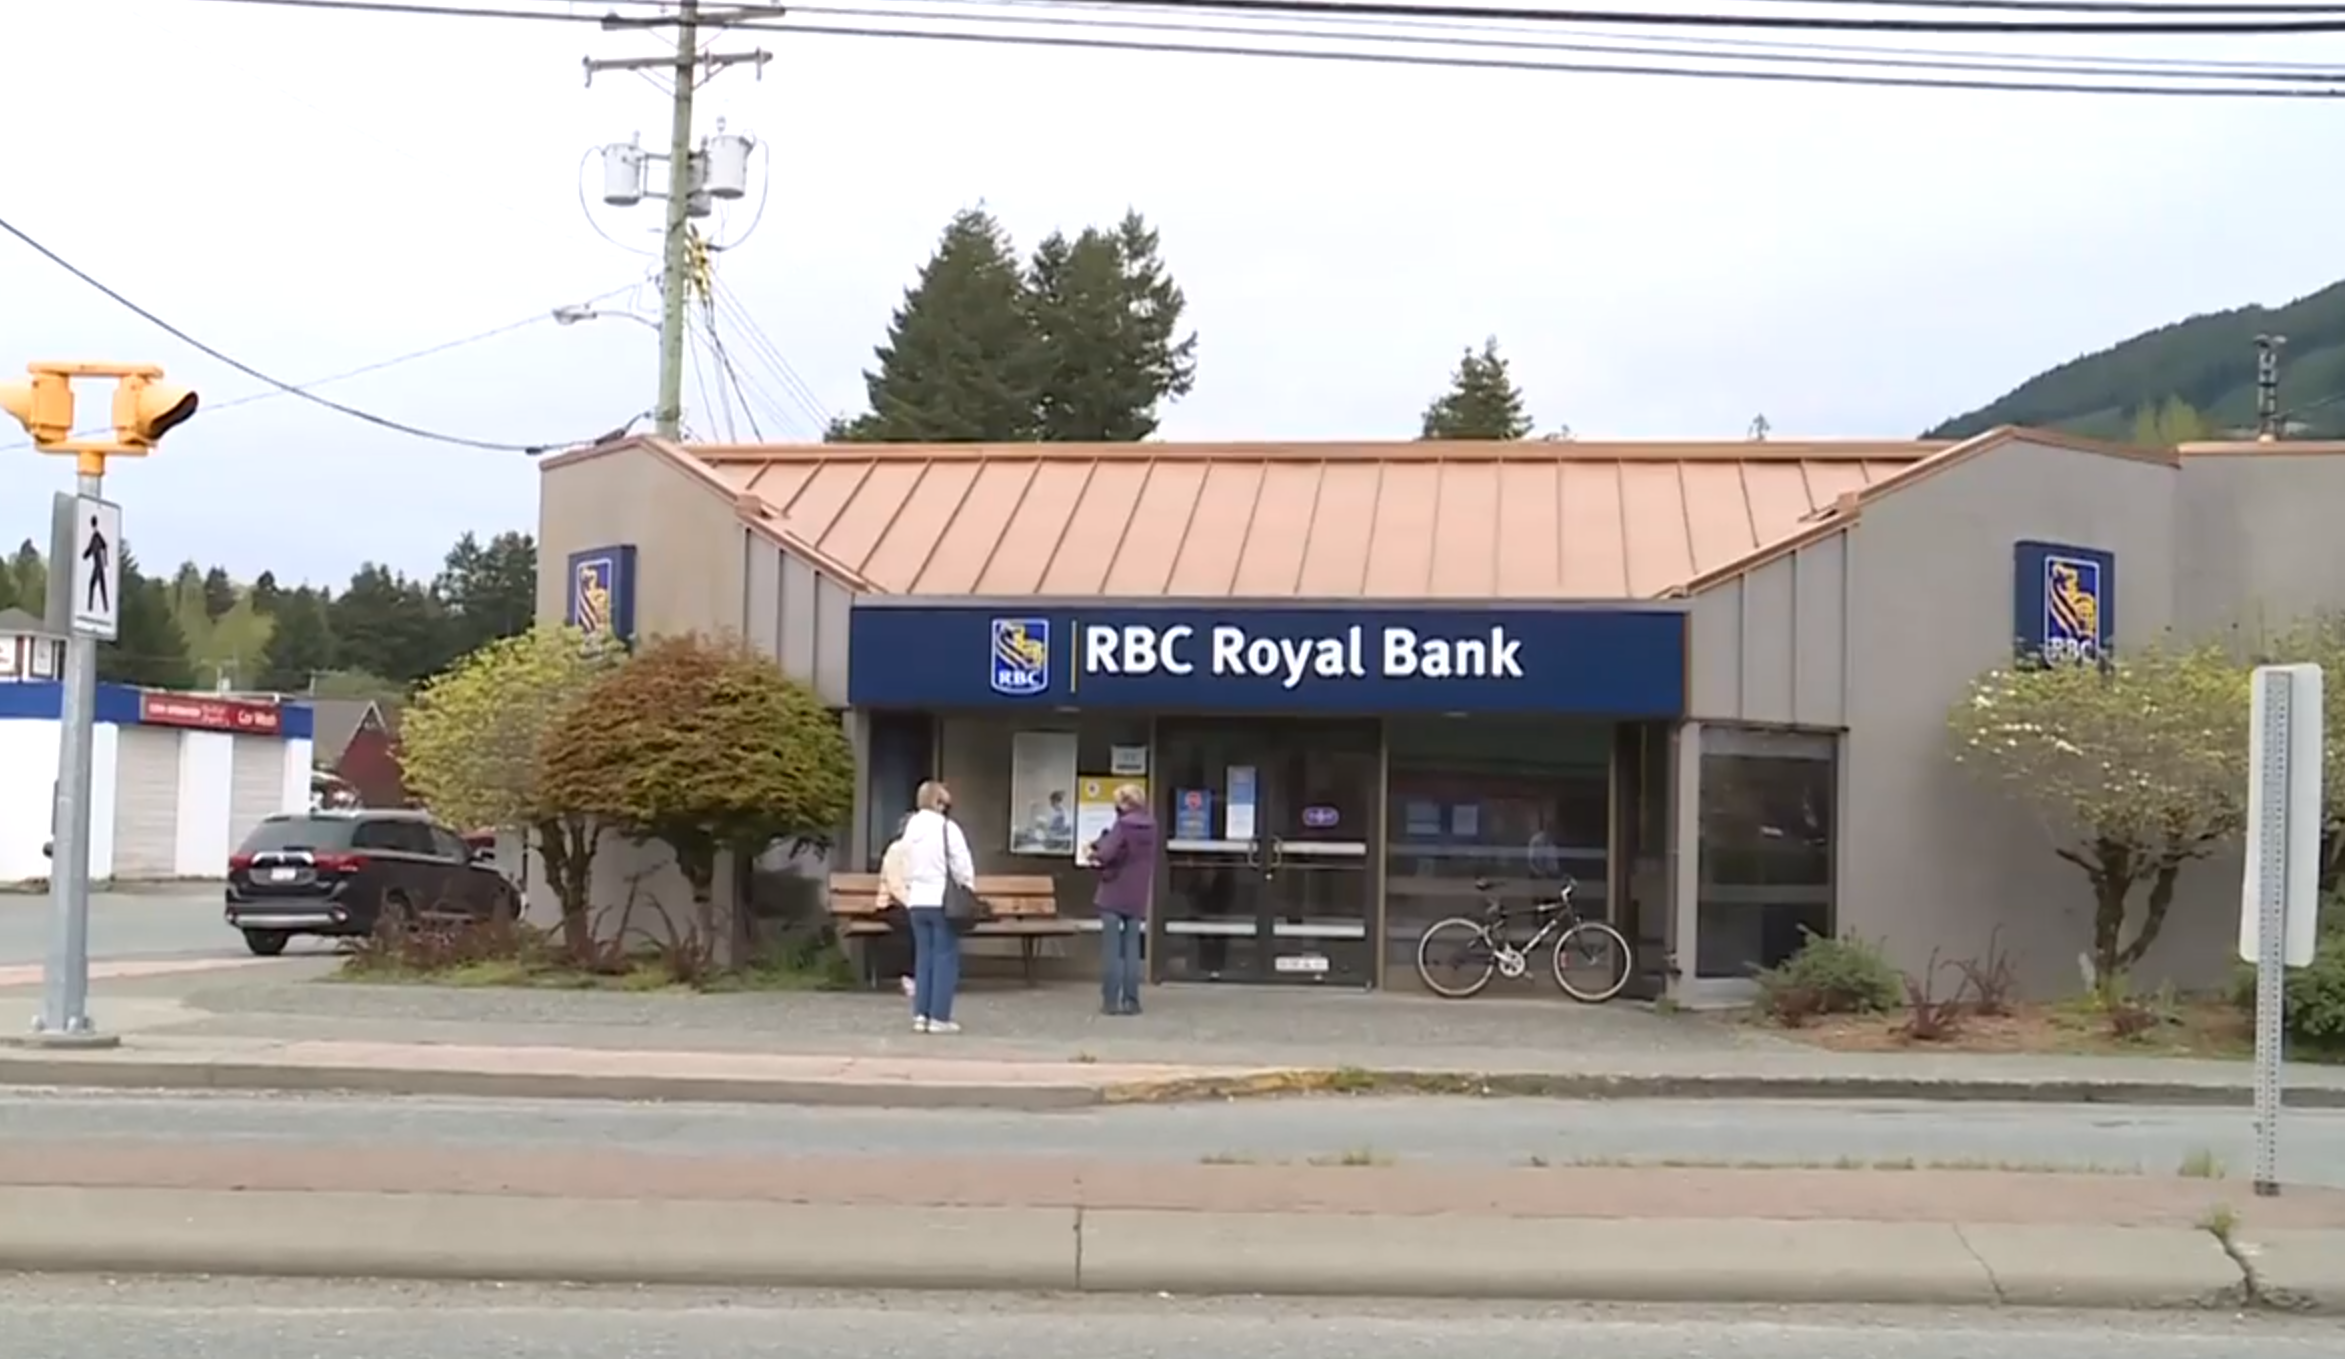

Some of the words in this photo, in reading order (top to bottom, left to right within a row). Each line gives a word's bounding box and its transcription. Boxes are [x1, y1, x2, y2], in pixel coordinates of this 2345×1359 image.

[1086, 625, 1194, 674] RBC
[1212, 625, 1366, 688] Royal
[1383, 626, 1524, 677] Bank
[2048, 637, 2096, 663] RBC
[998, 669, 1041, 686] RBC
